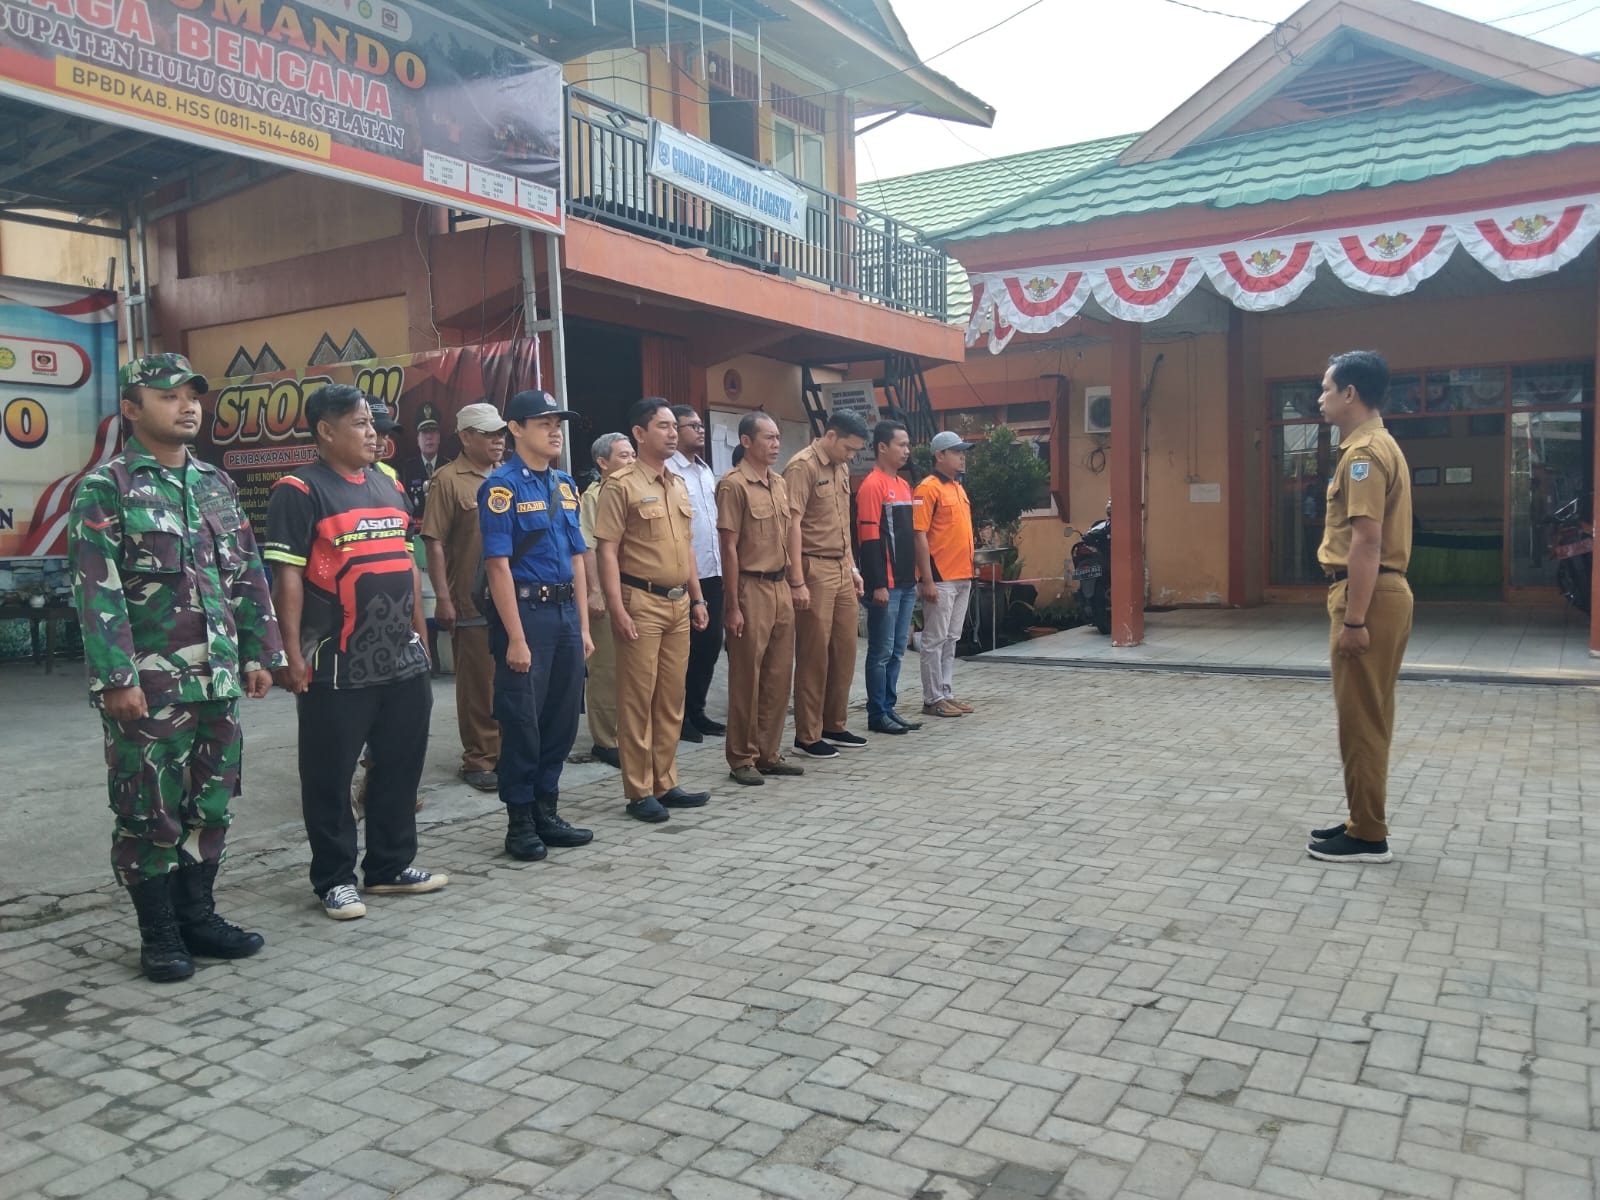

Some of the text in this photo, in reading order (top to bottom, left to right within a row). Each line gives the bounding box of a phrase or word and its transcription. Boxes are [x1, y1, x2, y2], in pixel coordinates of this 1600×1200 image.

[170, 0, 427, 90] MANDO
[177, 13, 392, 120] BENCANA
[72, 66, 319, 151] BPBD KAB. HSS (0811-514-686)
[138, 48, 215, 93] HULU
[218, 73, 307, 121] SUNGAI
[310, 101, 404, 149] SELATAN
[672, 146, 792, 225] GUDANG PERALATAN & LOGISTIK
[229, 448, 319, 464] PEMBAKARAN HUTA
[335, 532, 368, 546] FIRE
[356, 517, 404, 531] ASKUP
